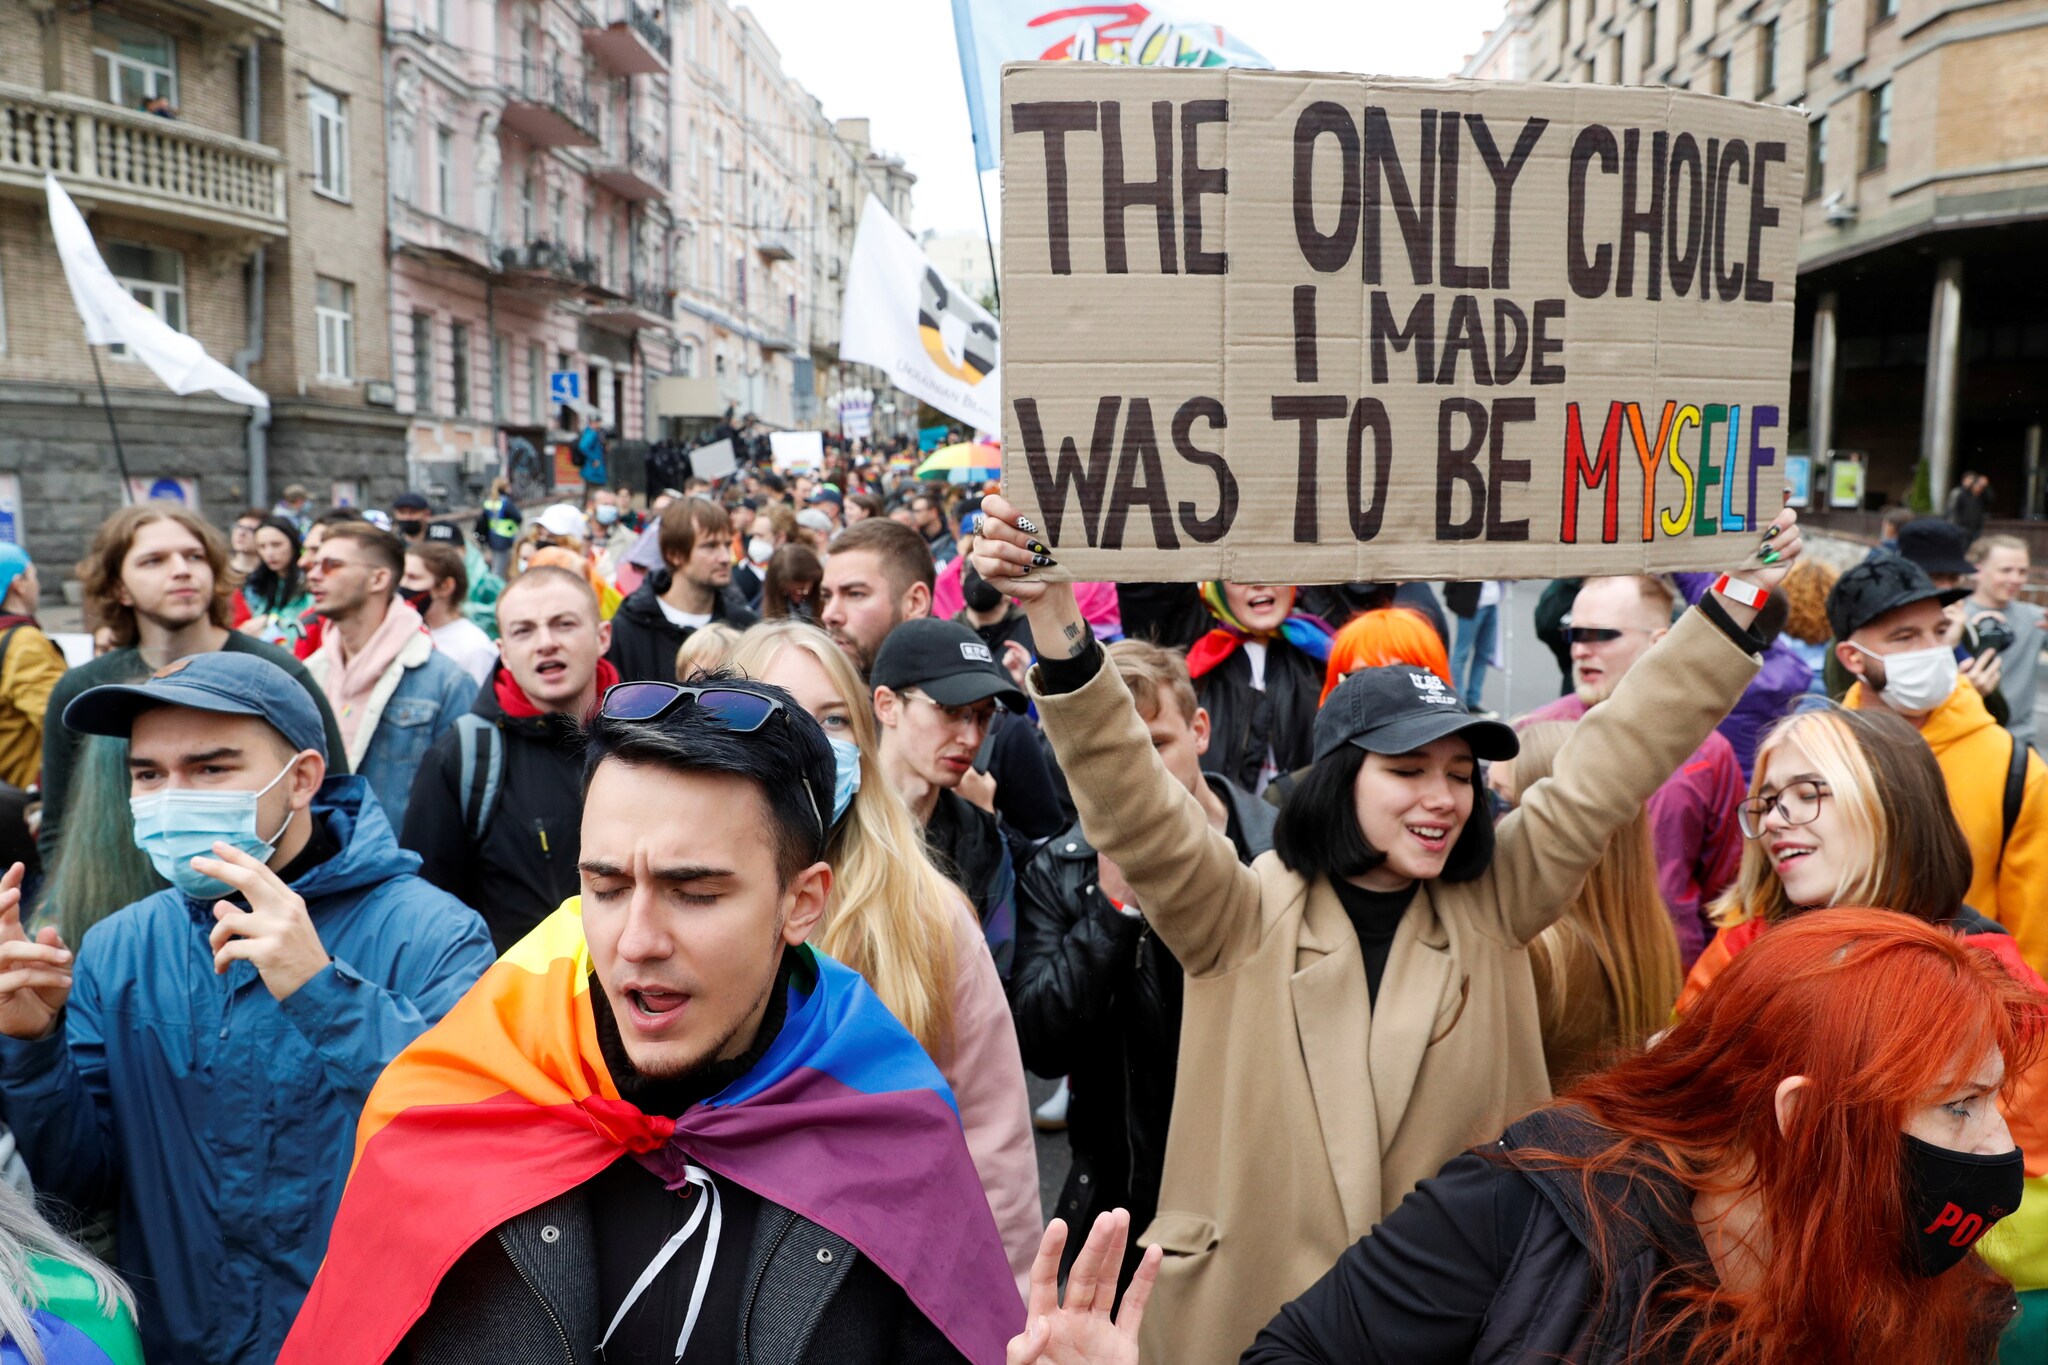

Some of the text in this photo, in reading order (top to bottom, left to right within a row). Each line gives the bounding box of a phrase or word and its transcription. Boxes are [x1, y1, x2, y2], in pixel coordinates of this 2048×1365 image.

[1012, 100, 1786, 302] THE ONLY CHOICE
[1294, 285, 1565, 386] I MADE
[1014, 396, 1779, 550] WAS TO BE MYSELF
